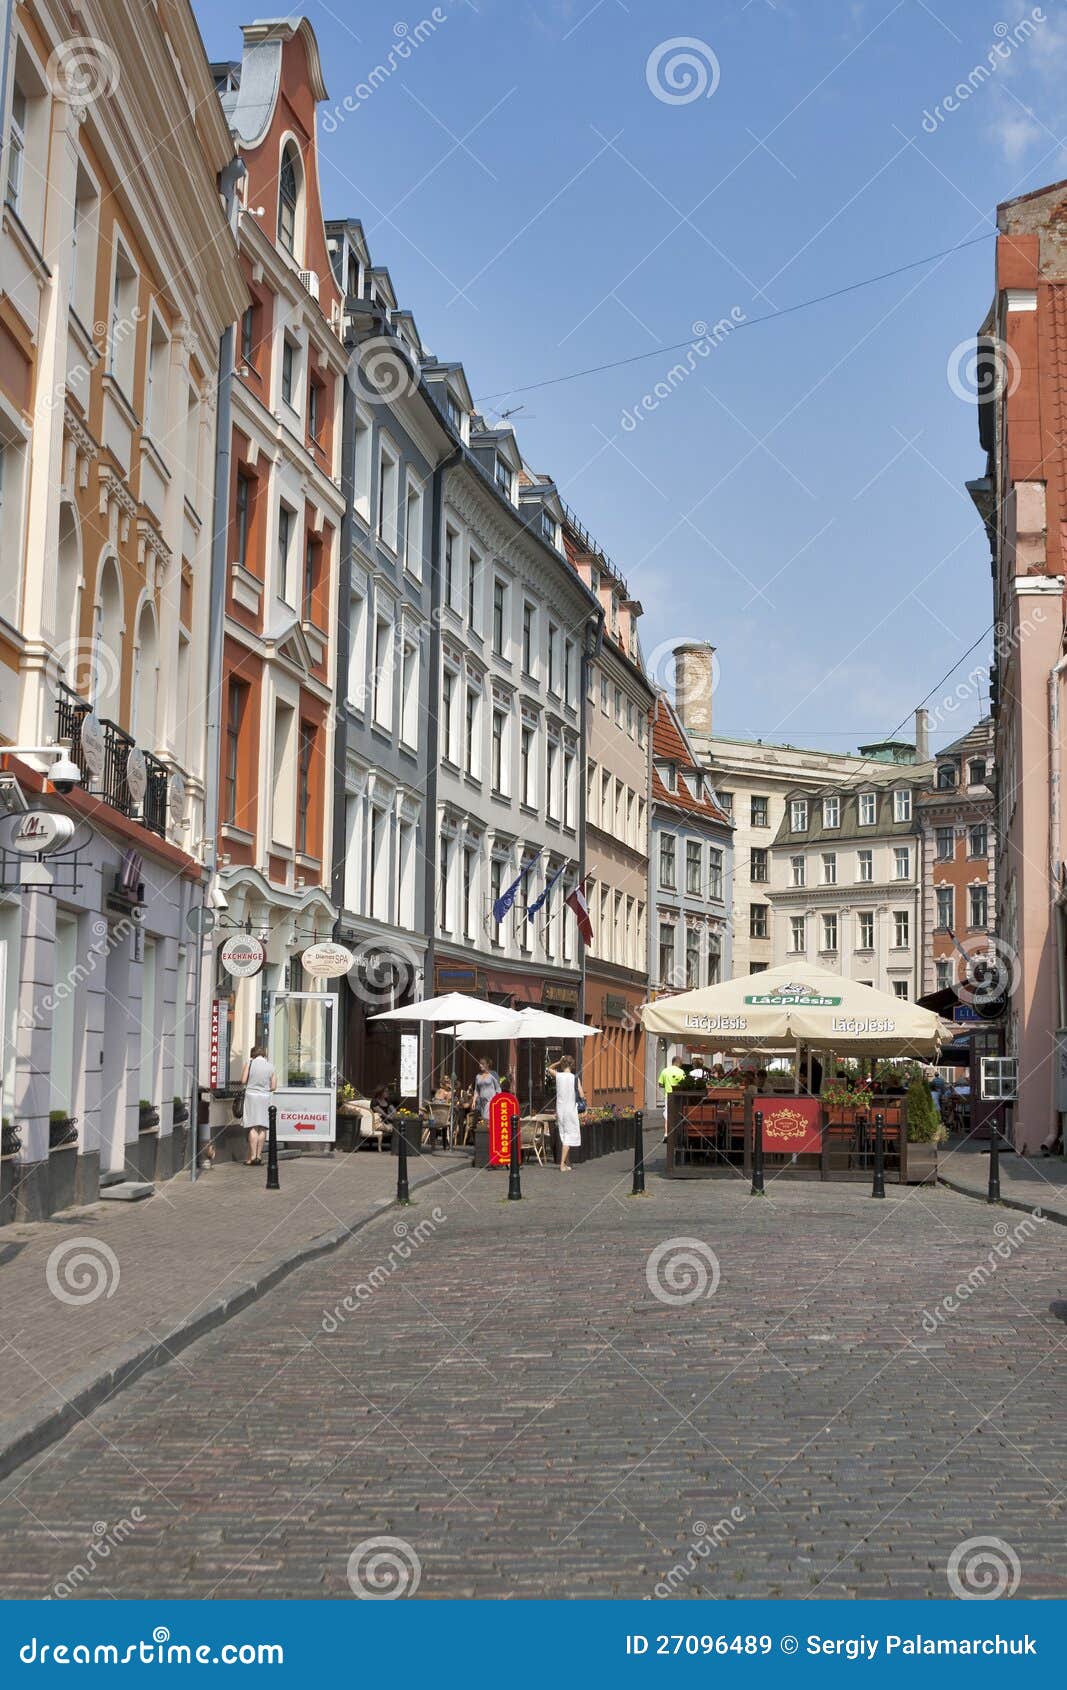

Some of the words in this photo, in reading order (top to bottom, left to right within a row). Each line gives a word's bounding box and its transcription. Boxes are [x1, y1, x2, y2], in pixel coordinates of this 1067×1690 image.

[335, 954, 349, 964] SPA
[280, 1113, 329, 1121] EXCHANGE
[500, 1102, 509, 1153] EXCHANGE
